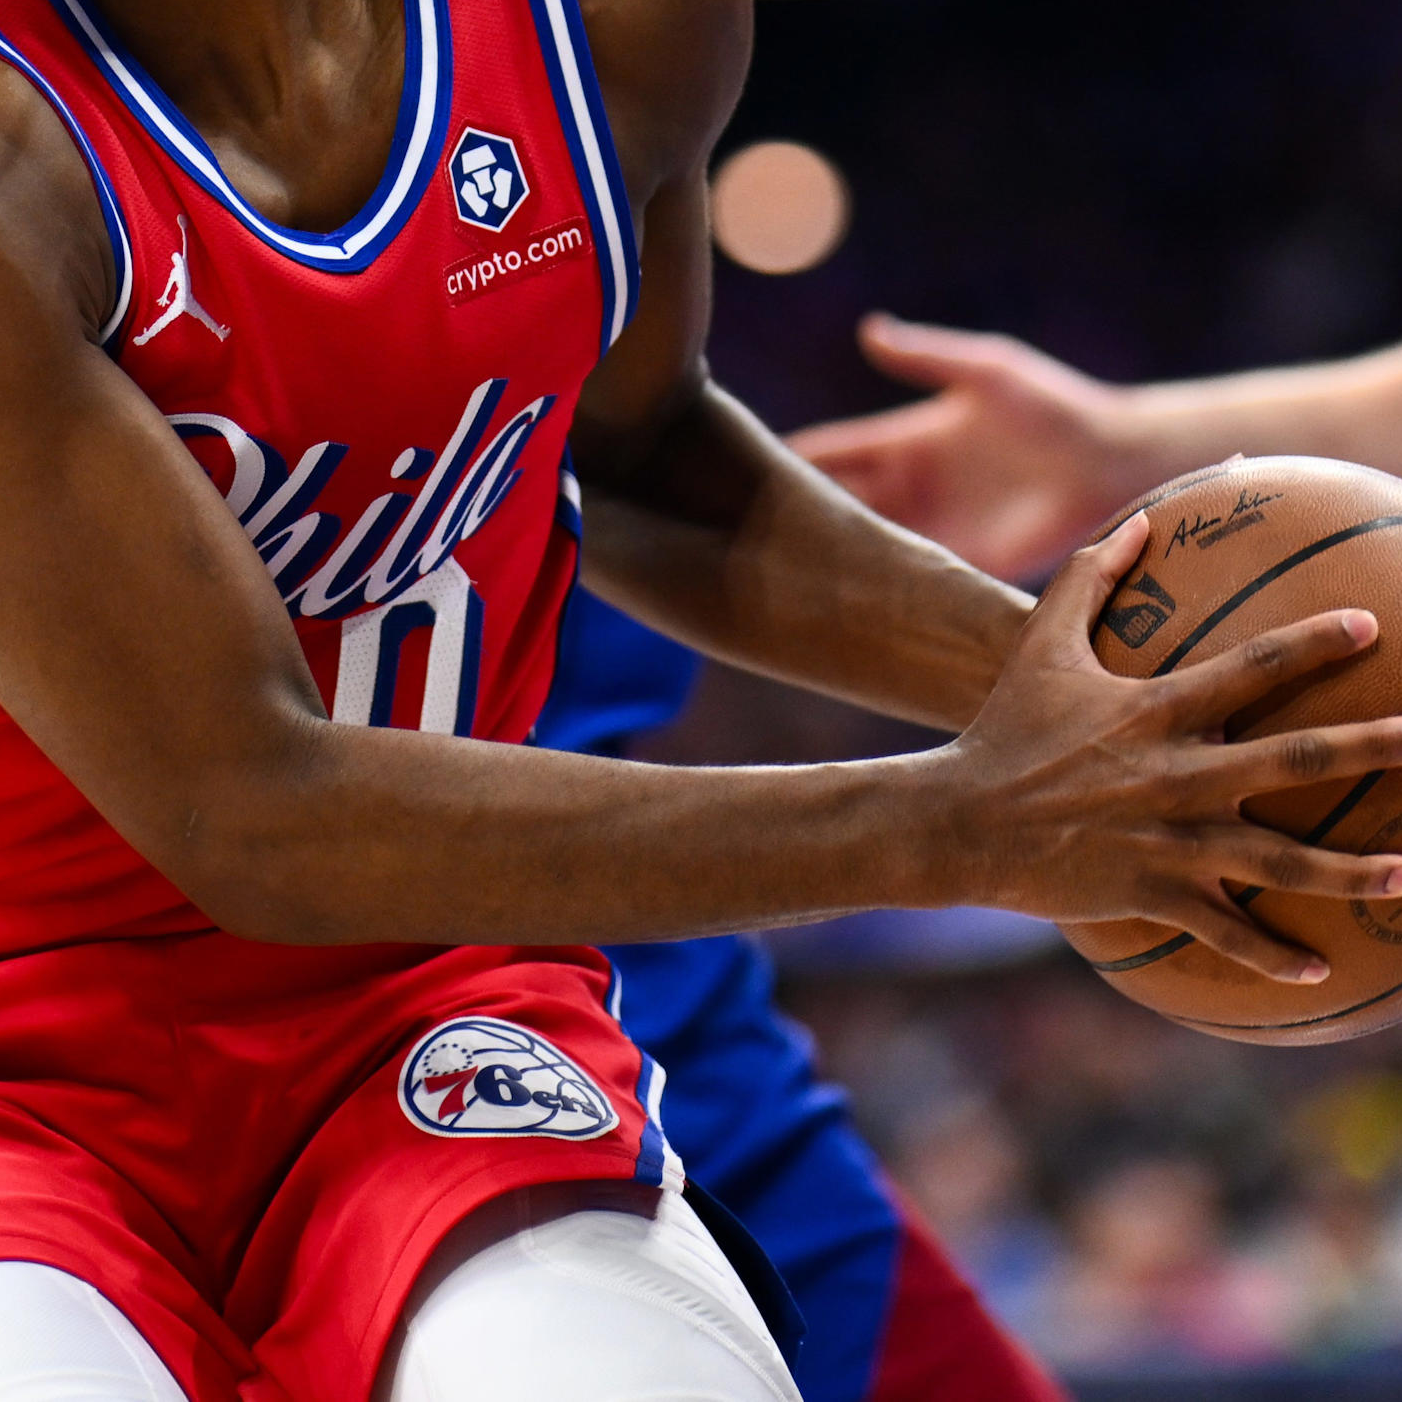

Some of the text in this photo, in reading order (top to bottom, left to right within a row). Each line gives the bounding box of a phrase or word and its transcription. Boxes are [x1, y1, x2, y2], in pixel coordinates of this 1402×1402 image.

[447, 227, 583, 295] crypto.com
[1123, 608, 1158, 640] NBA
[424, 1064, 603, 1122] 76ers
